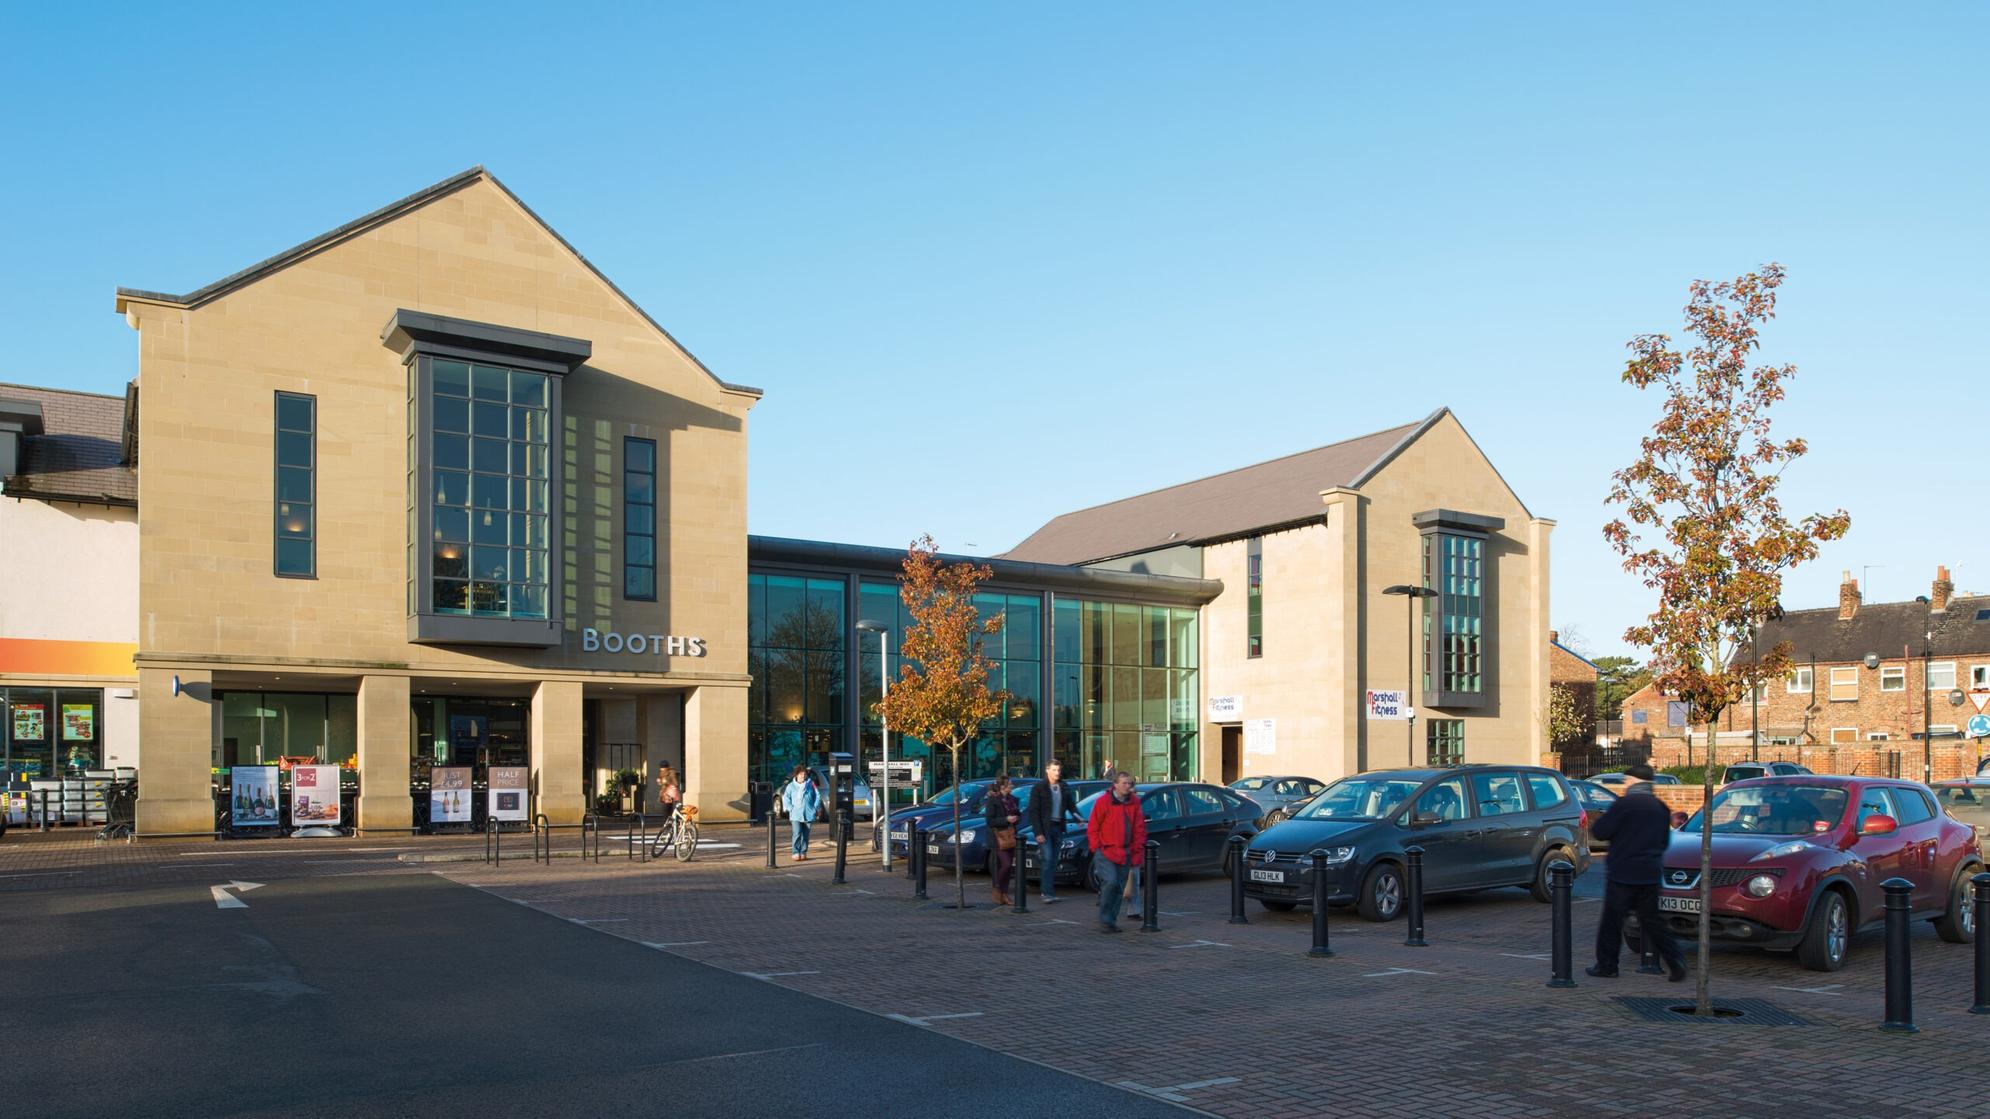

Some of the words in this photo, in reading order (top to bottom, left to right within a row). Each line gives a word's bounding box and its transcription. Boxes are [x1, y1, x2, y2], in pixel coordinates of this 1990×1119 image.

[583, 627, 703, 657] BOOTHS
[1367, 691, 1398, 705] Marshall
[497, 771, 520, 779] HALF
